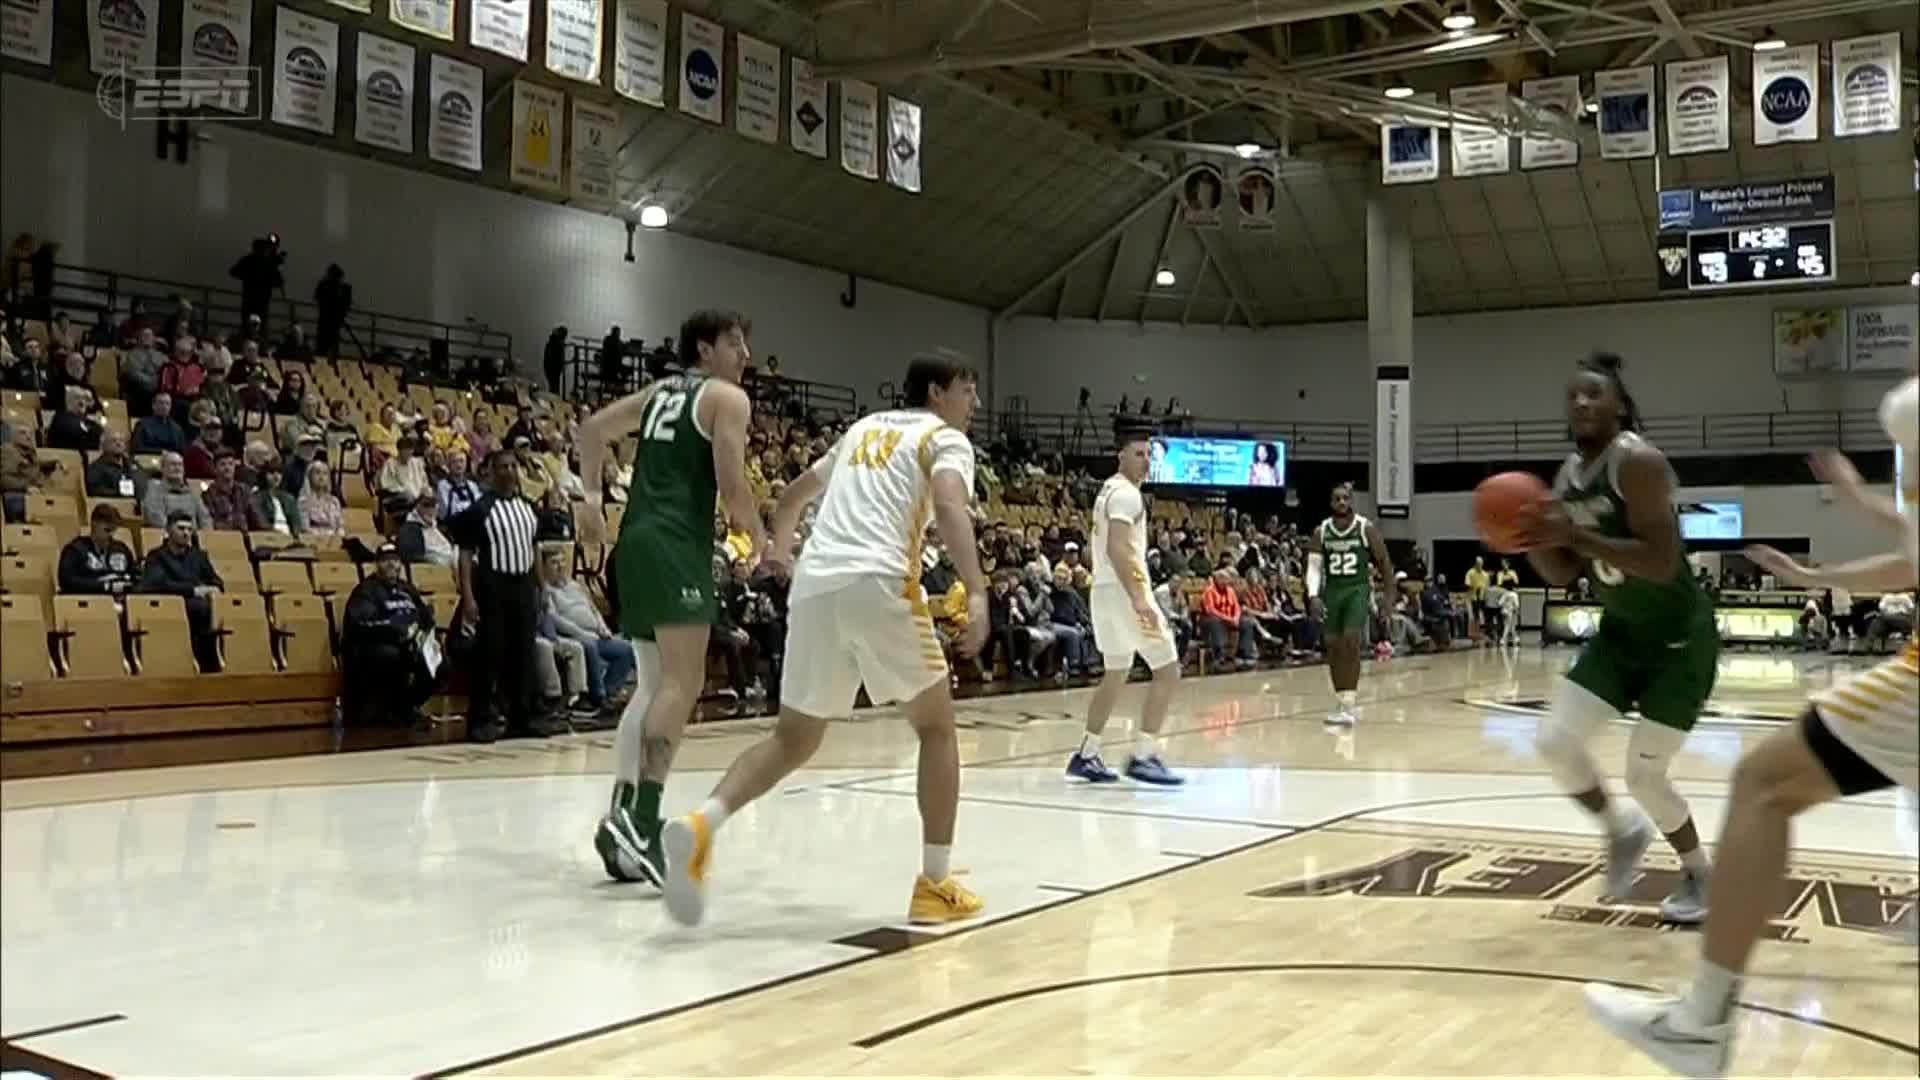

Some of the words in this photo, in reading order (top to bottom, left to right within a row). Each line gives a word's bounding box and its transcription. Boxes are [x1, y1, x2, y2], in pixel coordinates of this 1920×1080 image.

[1761, 89, 1810, 112] NCAA
[1787, 180, 1823, 194] Private
[1785, 194, 1812, 206] Bank
[643, 389, 687, 442] 12
[1328, 552, 1359, 576] 22
